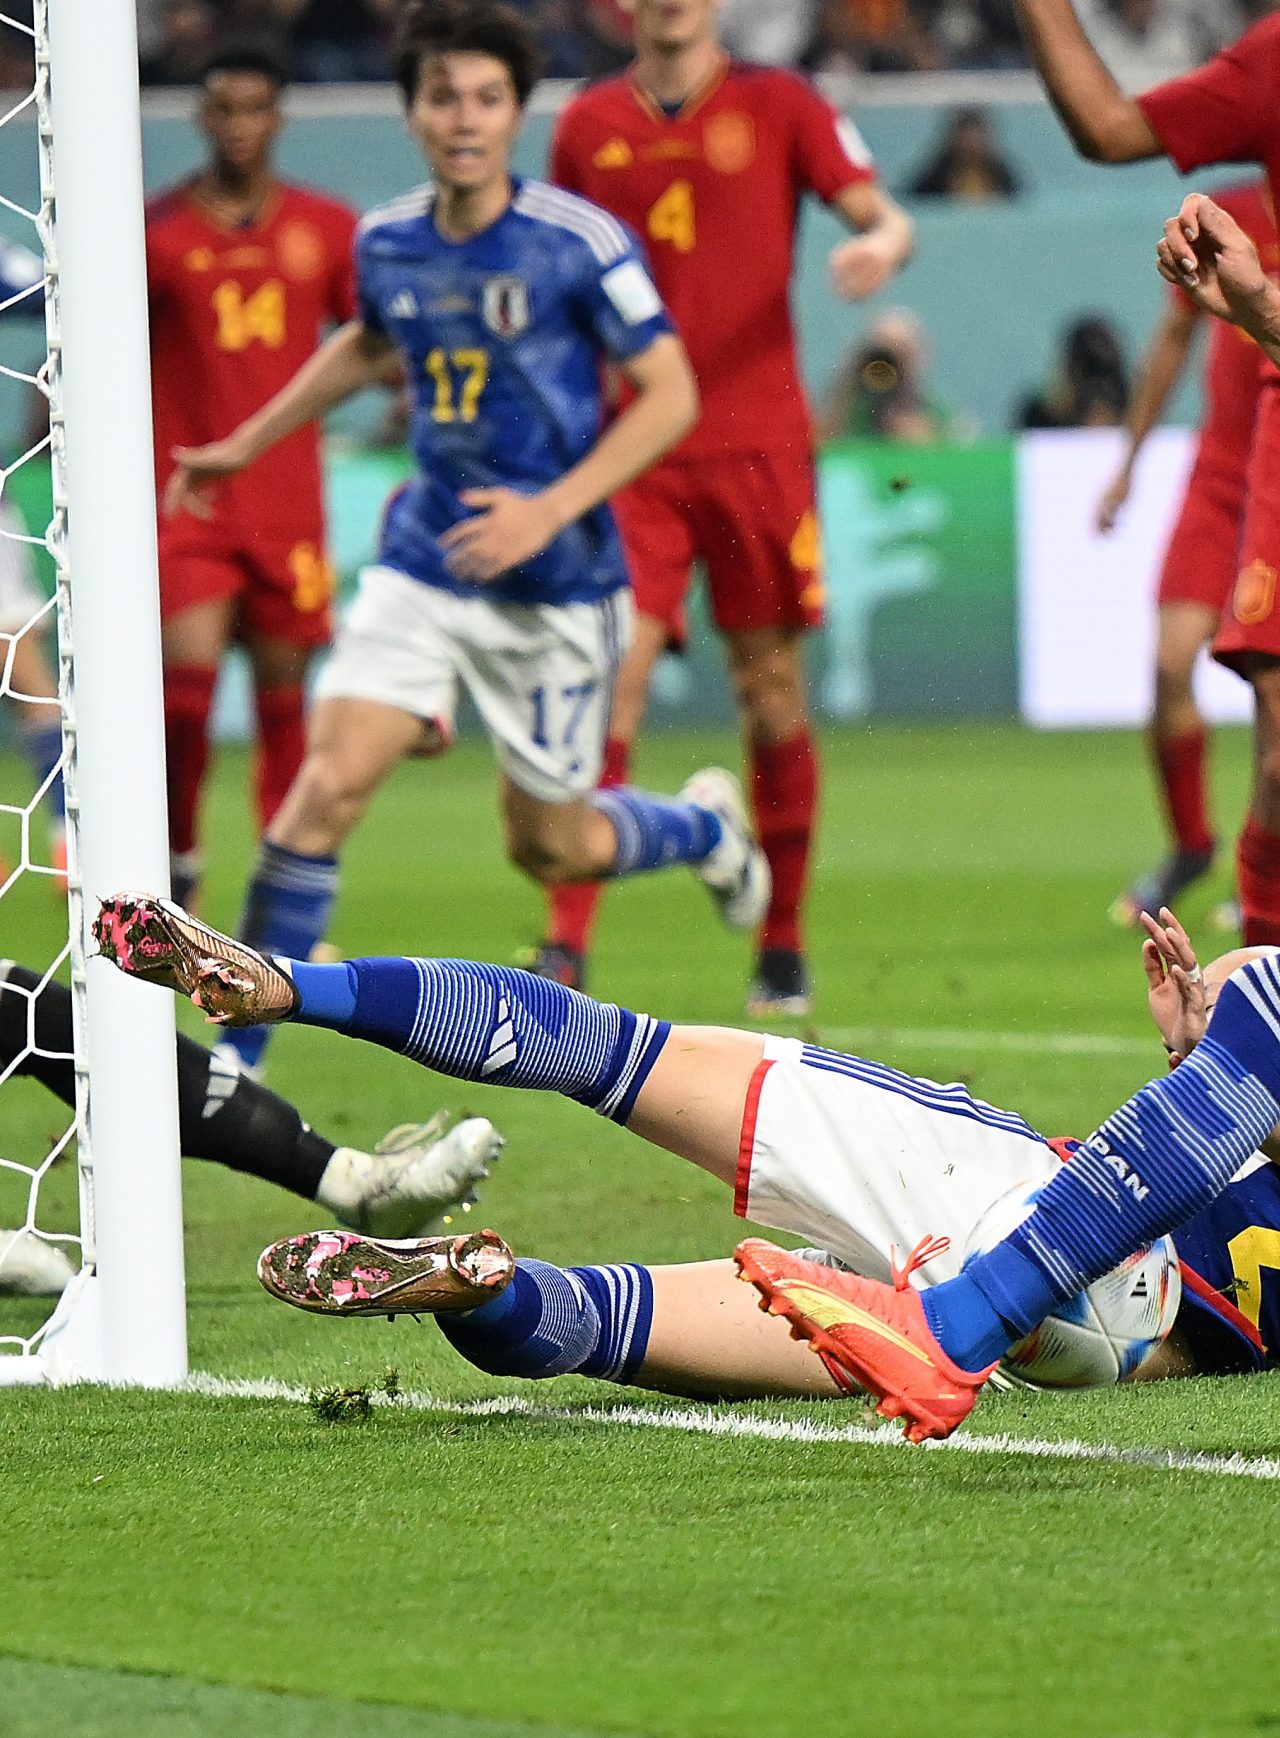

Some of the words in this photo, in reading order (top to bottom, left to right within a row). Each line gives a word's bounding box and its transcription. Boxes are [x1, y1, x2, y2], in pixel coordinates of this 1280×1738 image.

[647, 178, 696, 252] 4
[213, 279, 286, 348] 14
[427, 349, 488, 421] 17
[531, 682, 597, 748] 17
[1086, 1131, 1149, 1201] PAN
